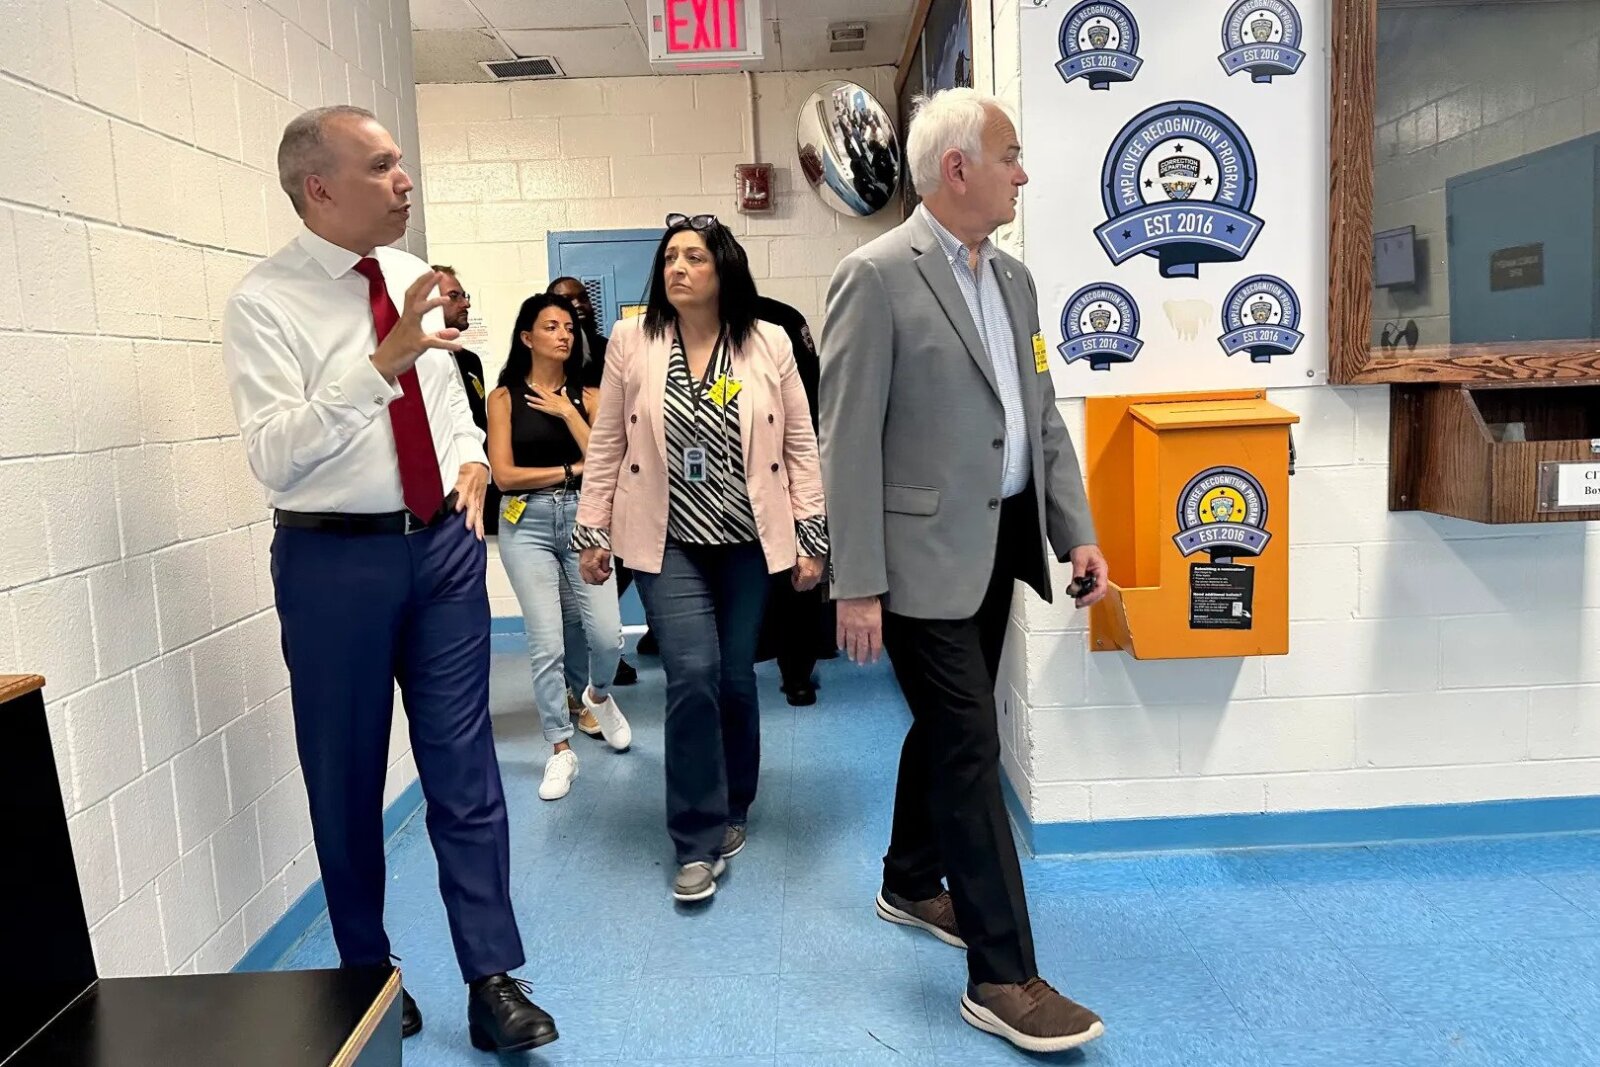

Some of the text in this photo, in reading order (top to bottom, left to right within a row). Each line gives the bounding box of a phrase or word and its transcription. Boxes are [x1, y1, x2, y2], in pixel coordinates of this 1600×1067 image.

[666, 0, 738, 50] EXIT
[1069, 17, 1080, 52] EMPLOYEE
[1079, 6, 1120, 20] RECOGNITION
[1119, 17, 1130, 50] PROGRAM
[1231, 10, 1244, 45] EMPLOYEE
[1242, 0, 1282, 13] RECOGNITION
[1280, 11, 1293, 44] PROGRAM
[1098, 56, 1117, 68] 2016
[1260, 49, 1280, 60] 2016
[1121, 118, 1238, 206] EMPLOYEE RECOGNITION PROGRAM
[1160, 158, 1198, 168] CORRECTION
[1160, 164, 1198, 173] DEPARTMENT
[1144, 213, 1213, 237] EST. 2016
[1070, 302, 1082, 335] EMPLOYEE
[1081, 290, 1121, 304] RECOGNITION
[1119, 301, 1130, 333] PROGRAM
[1231, 294, 1244, 327] EMPLOYEE
[1242, 282, 1282, 296] RECOGNITION
[1280, 293, 1291, 325] PROGRAM
[1099, 338, 1118, 349] 2016
[1260, 330, 1278, 341] 2016
[1585, 471, 1600, 479] CI
[1188, 488, 1201, 525] EMPLOYEE
[1200, 475, 1248, 492] RECOGNITION
[1245, 489, 1258, 525] PROGRAM
